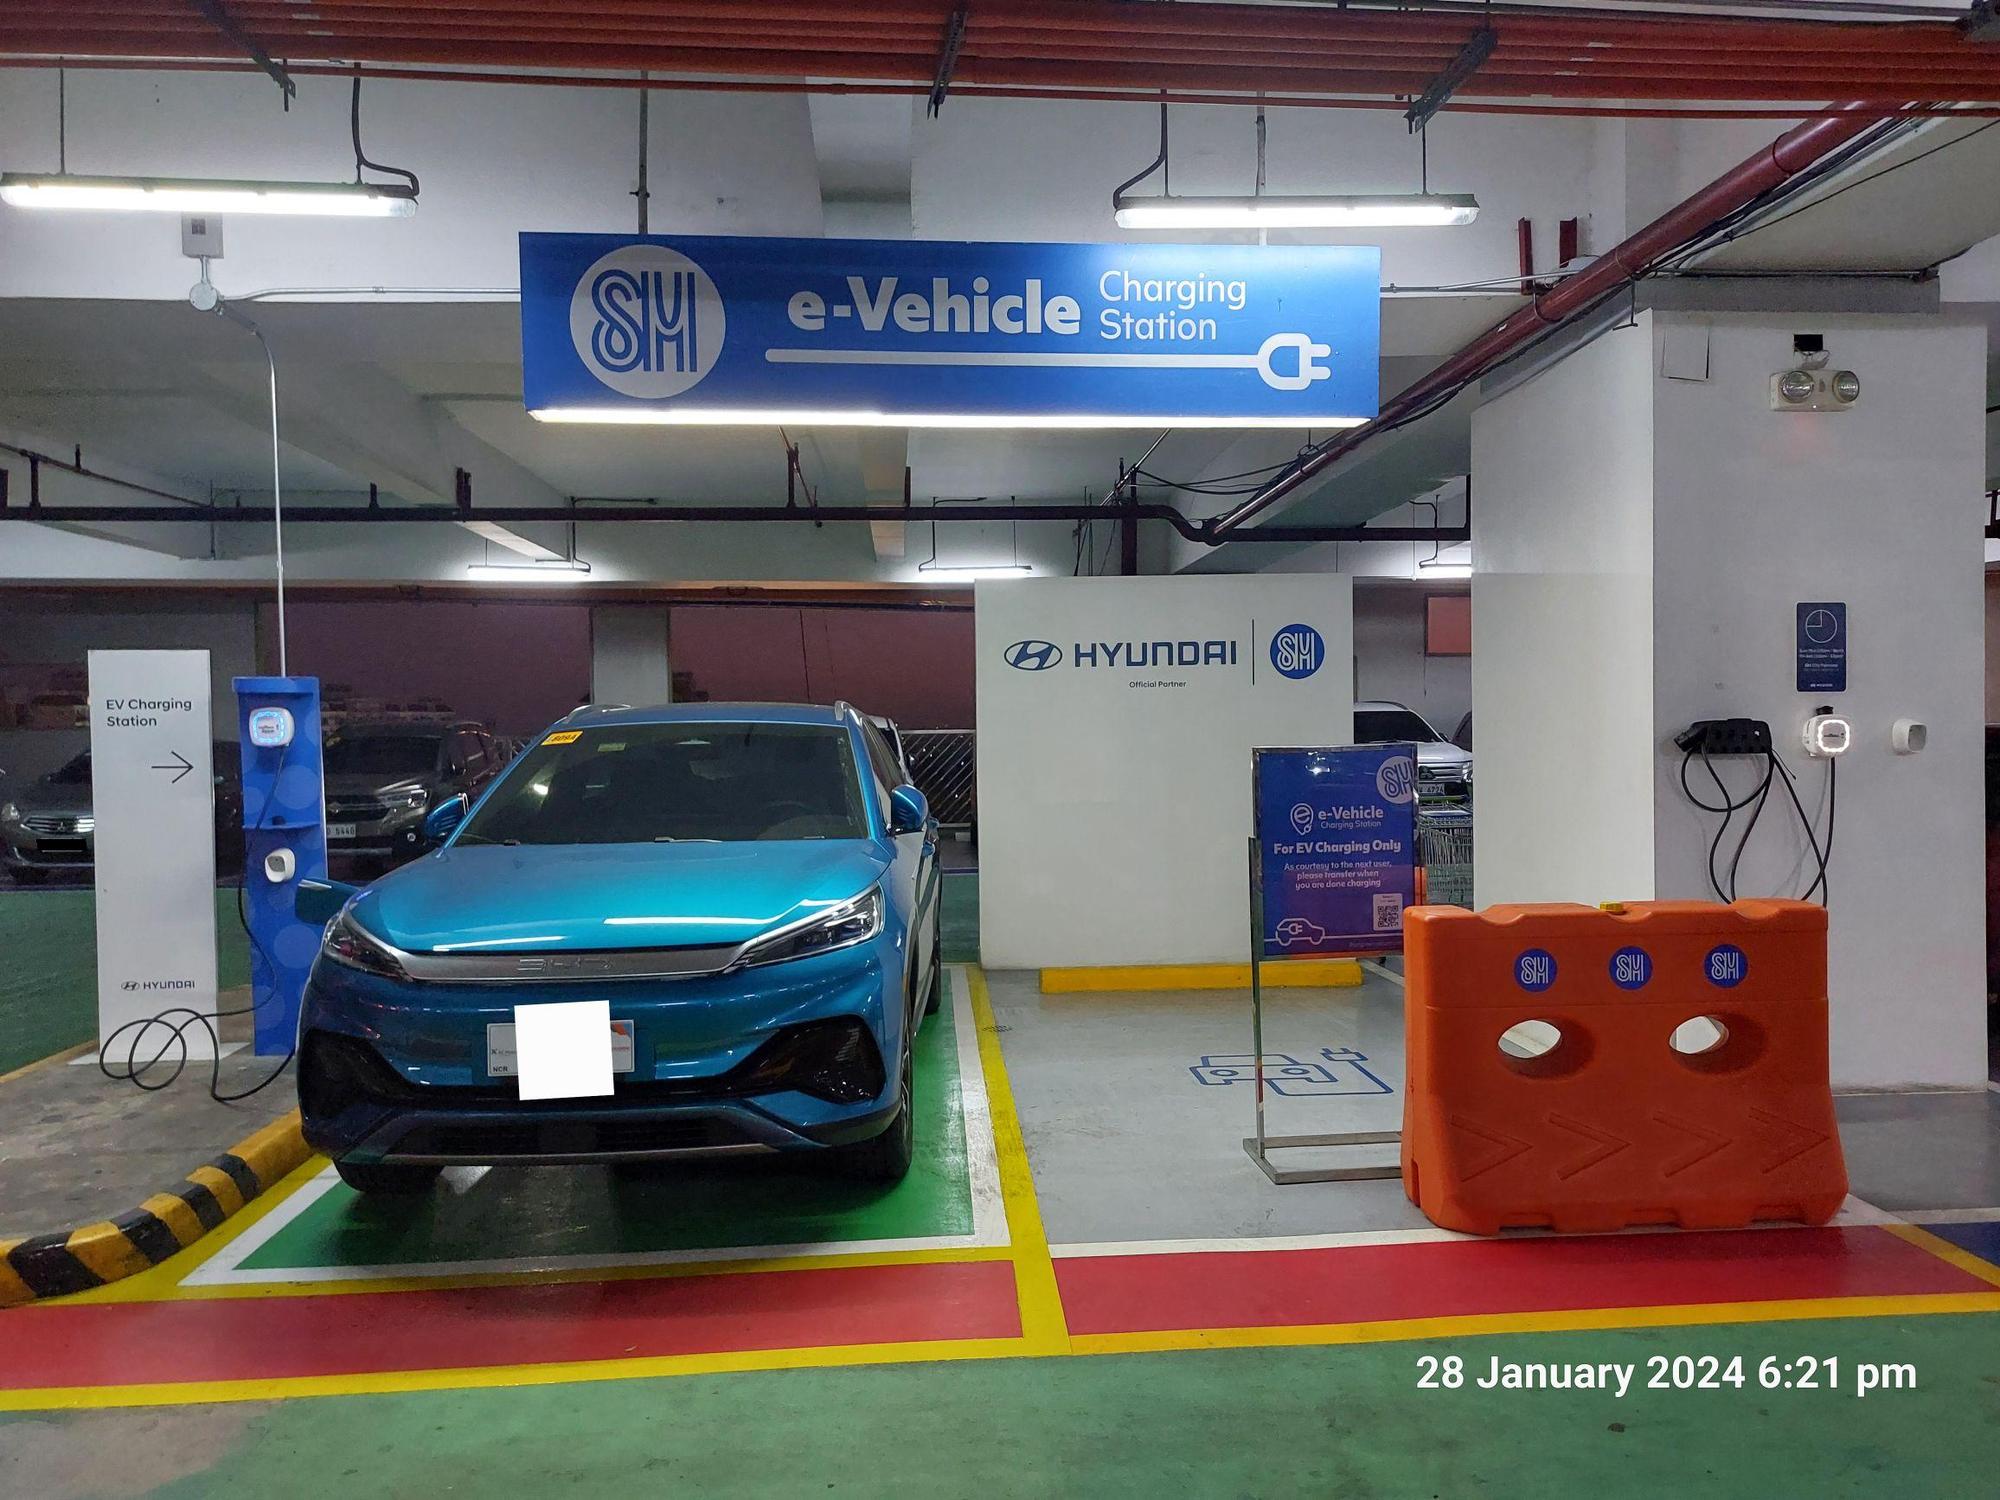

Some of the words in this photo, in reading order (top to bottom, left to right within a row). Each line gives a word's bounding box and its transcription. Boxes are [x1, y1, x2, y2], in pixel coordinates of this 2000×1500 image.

[1099, 270, 1247, 310] Charging
[787, 276, 1081, 335] e-Vehicle
[591, 269, 697, 373] SM
[1099, 309, 1217, 340] Station
[1074, 641, 1237, 667] HYUNDAI
[1276, 632, 1315, 671] SM
[1129, 680, 1156, 688] Official
[1158, 680, 1187, 688] Partner
[106, 699, 124, 710] EV
[128, 697, 192, 712] Charging
[106, 715, 157, 727] Station
[1318, 805, 1384, 820] e-Vehicle
[1320, 820, 1354, 830] Charging
[1355, 819, 1382, 828] Station
[1273, 843, 1294, 855] For
[1296, 842, 1314, 854] EV
[1315, 840, 1371, 855] Charging
[1372, 839, 1402, 853] Only
[1284, 863, 1295, 871] As
[1296, 862, 1330, 872] courtesy
[1331, 861, 1339, 869] to
[1340, 861, 1354, 869] the
[1297, 871, 1325, 880] please
[1325, 870, 1357, 879] transfer
[1357, 869, 1379, 878] when
[1295, 882, 1310, 891] you
[1326, 880, 1346, 888] done
[1347, 879, 1381, 889] charging
[1521, 956, 1549, 984] SM
[1616, 954, 1644, 982] SM
[1711, 952, 1739, 980] SM
[143, 980, 196, 990] HYUNDAI
